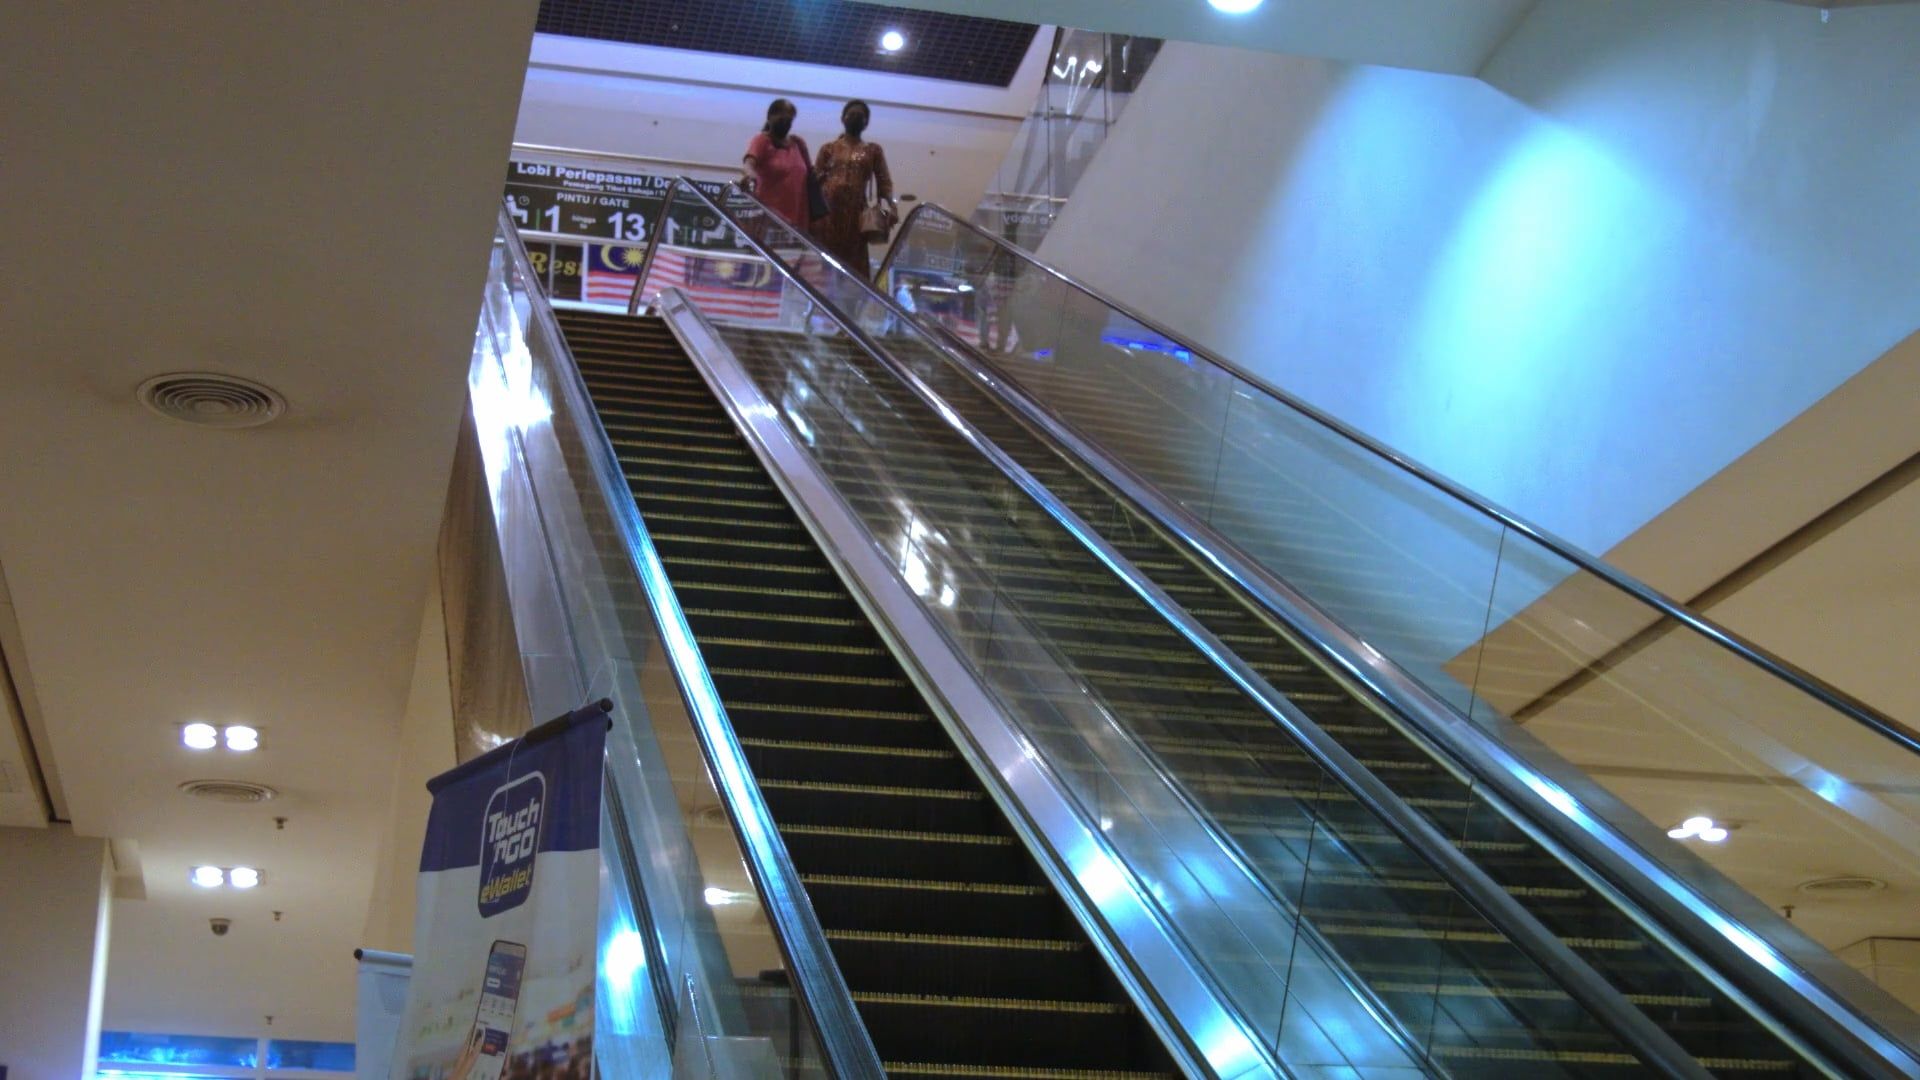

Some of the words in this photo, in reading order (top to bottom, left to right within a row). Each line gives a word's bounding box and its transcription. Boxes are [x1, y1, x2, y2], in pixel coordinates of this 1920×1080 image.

[517, 162, 551, 177] Lobi
[555, 165, 643, 190] Perlepasan
[557, 192, 590, 204] PINTU
[592, 196, 597, 205] /
[600, 197, 630, 209] GATE
[545, 204, 561, 233] 1
[608, 211, 647, 242] 13
[488, 797, 541, 844] Touch
[479, 864, 532, 903] eWallet
